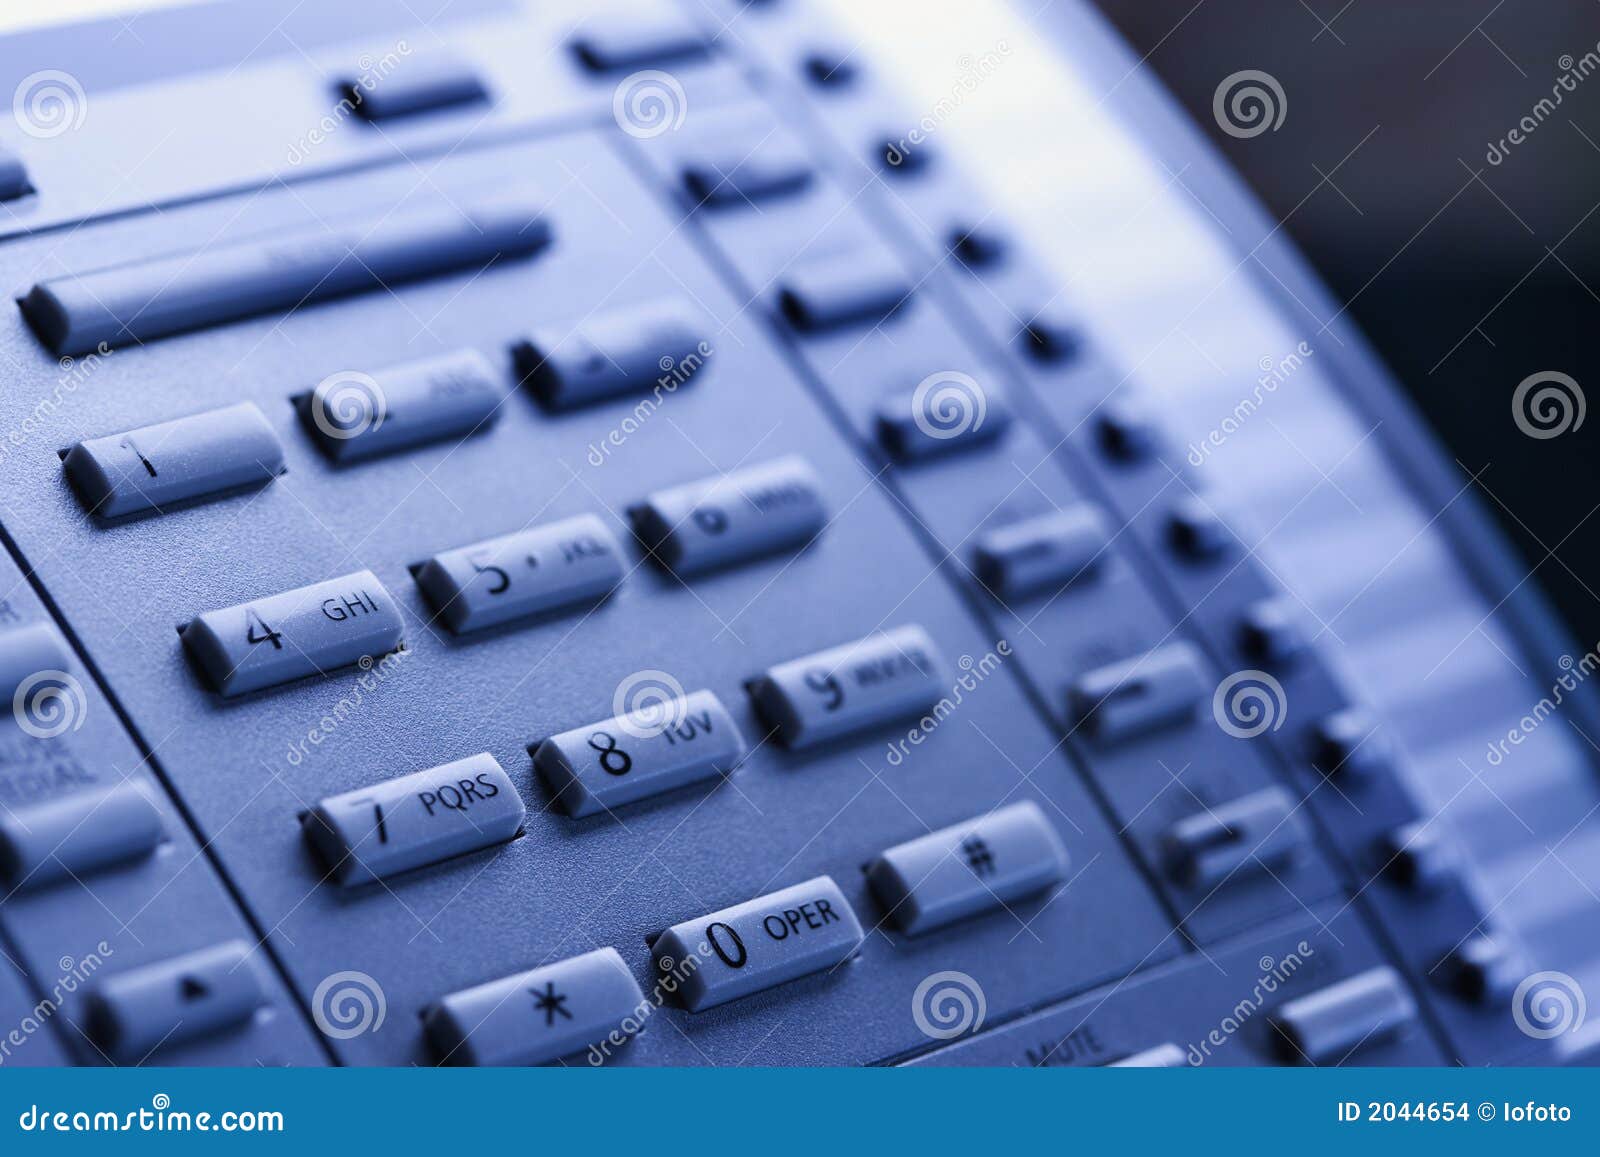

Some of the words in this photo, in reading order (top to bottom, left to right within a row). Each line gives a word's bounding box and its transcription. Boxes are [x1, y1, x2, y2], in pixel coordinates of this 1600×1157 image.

[247, 605, 282, 650] 4
[321, 590, 379, 622] GHI
[804, 668, 844, 713] 9
[587, 731, 632, 776] 8
[350, 797, 388, 843] 7
[418, 773, 500, 816] PQRS
[706, 922, 747, 968] 0
[763, 899, 840, 941] OPER
